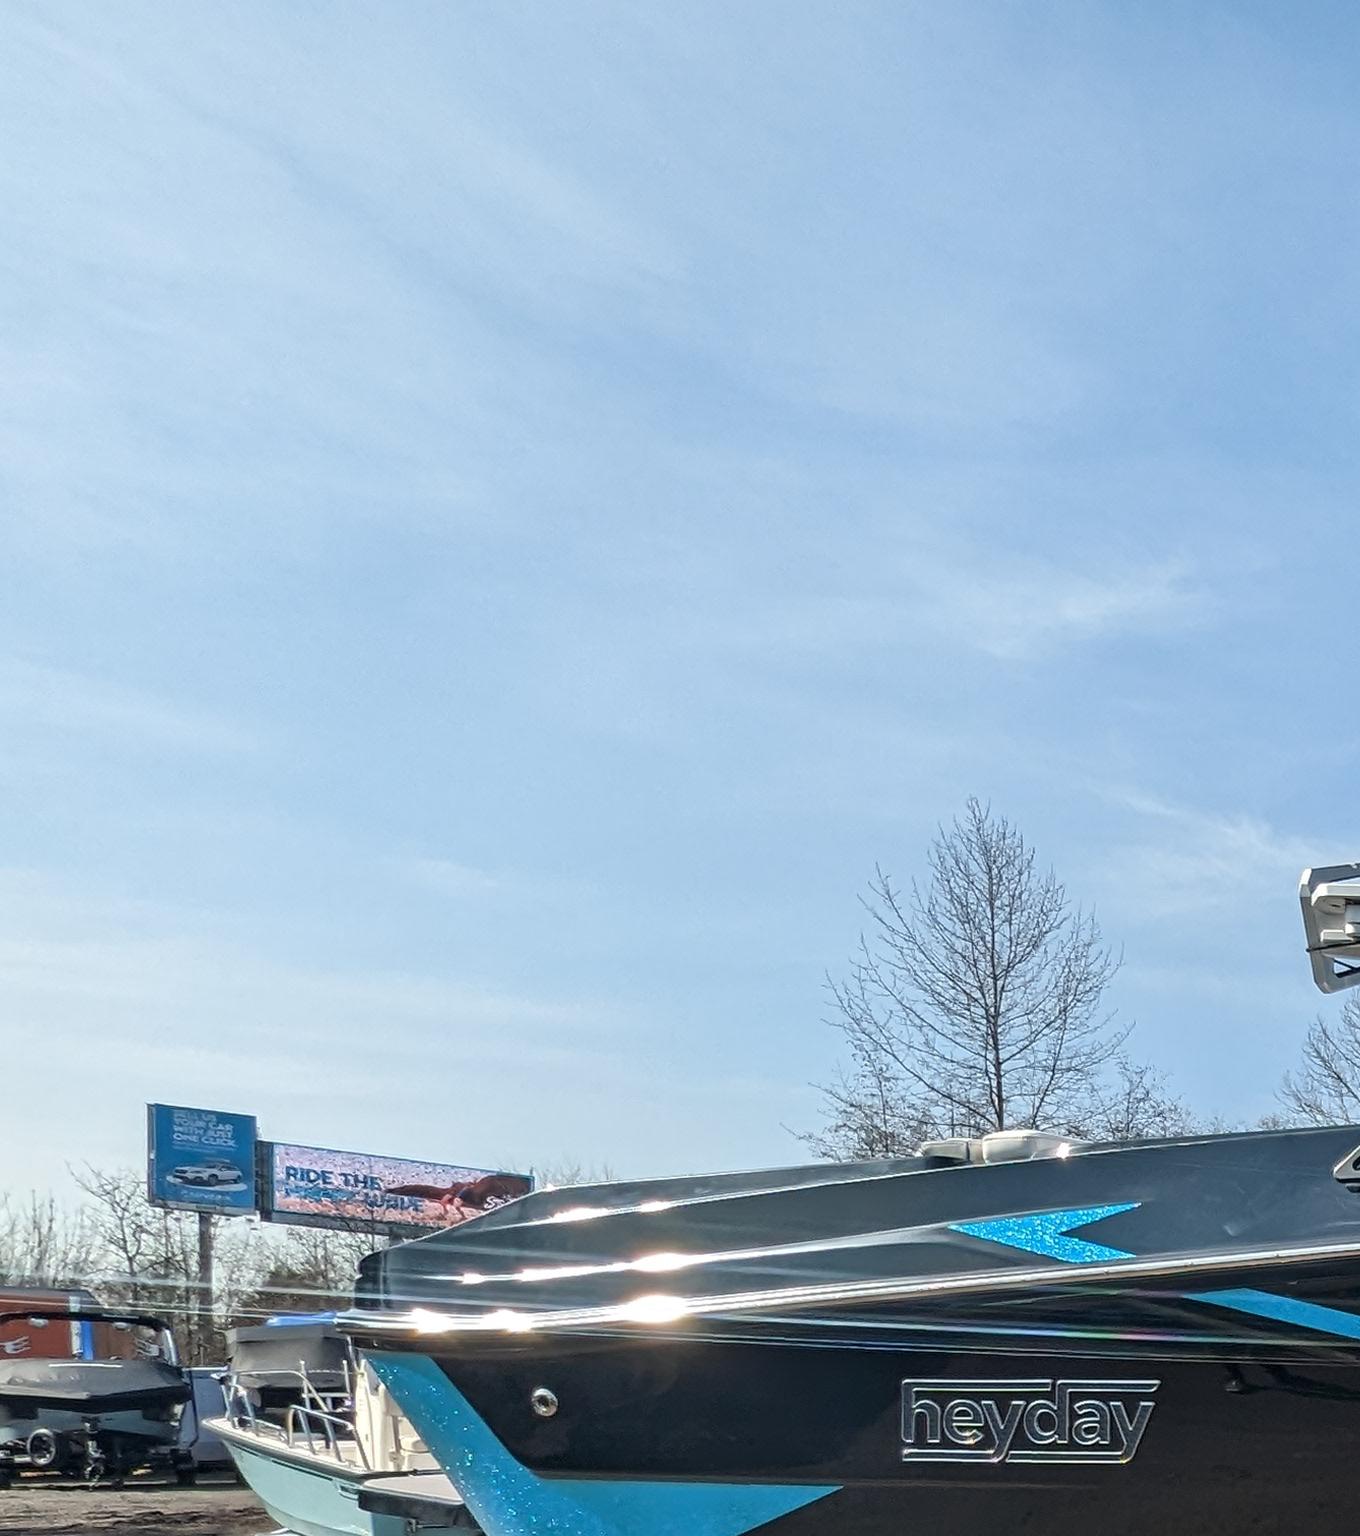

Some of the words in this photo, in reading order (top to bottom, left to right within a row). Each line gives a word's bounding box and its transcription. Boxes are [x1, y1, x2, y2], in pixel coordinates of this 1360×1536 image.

[285, 1165, 334, 1185] RIDE
[339, 1172, 382, 1191] THE
[901, 1379, 1161, 1464] heyday
